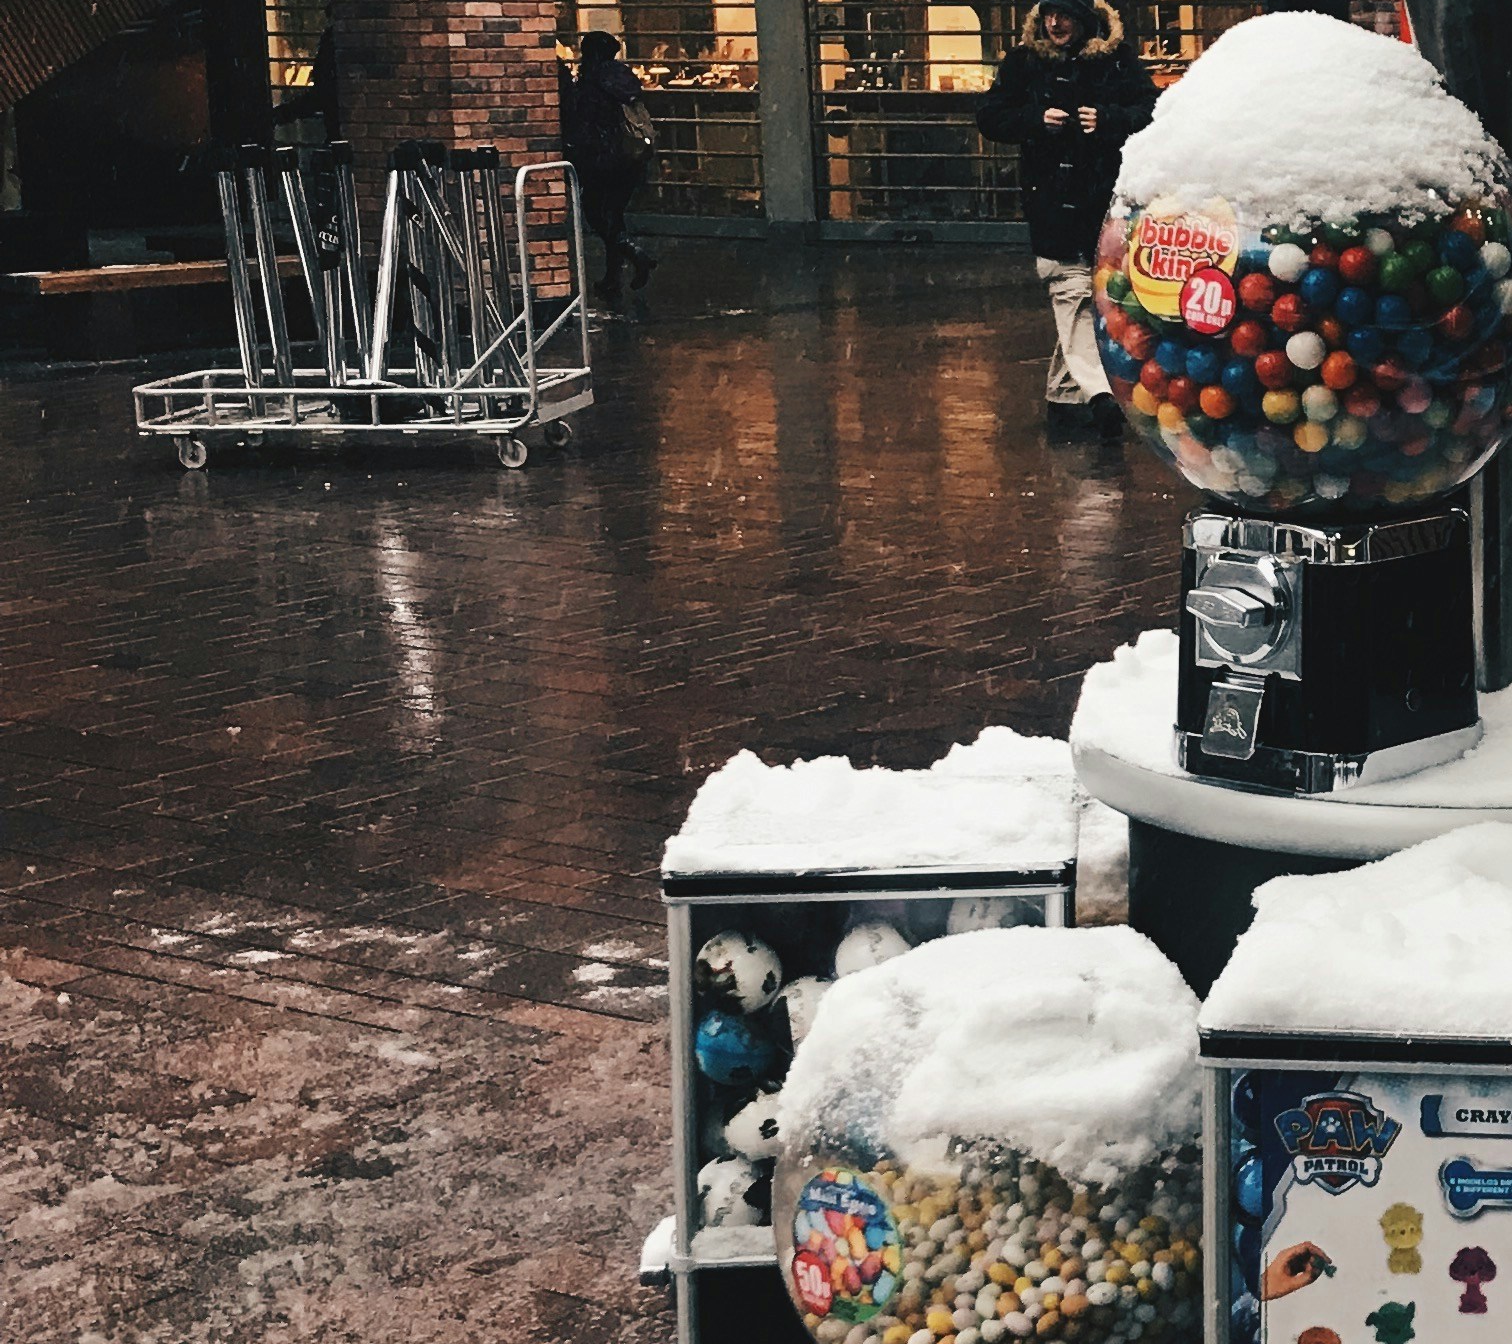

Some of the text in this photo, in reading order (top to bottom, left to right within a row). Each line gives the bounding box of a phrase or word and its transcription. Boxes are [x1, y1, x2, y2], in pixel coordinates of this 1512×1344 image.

[1140, 214, 1235, 256] bubble
[1186, 277, 1233, 317] 20p
[1273, 1107, 1403, 1159] PAW
[1303, 1158, 1369, 1176] PATROL
